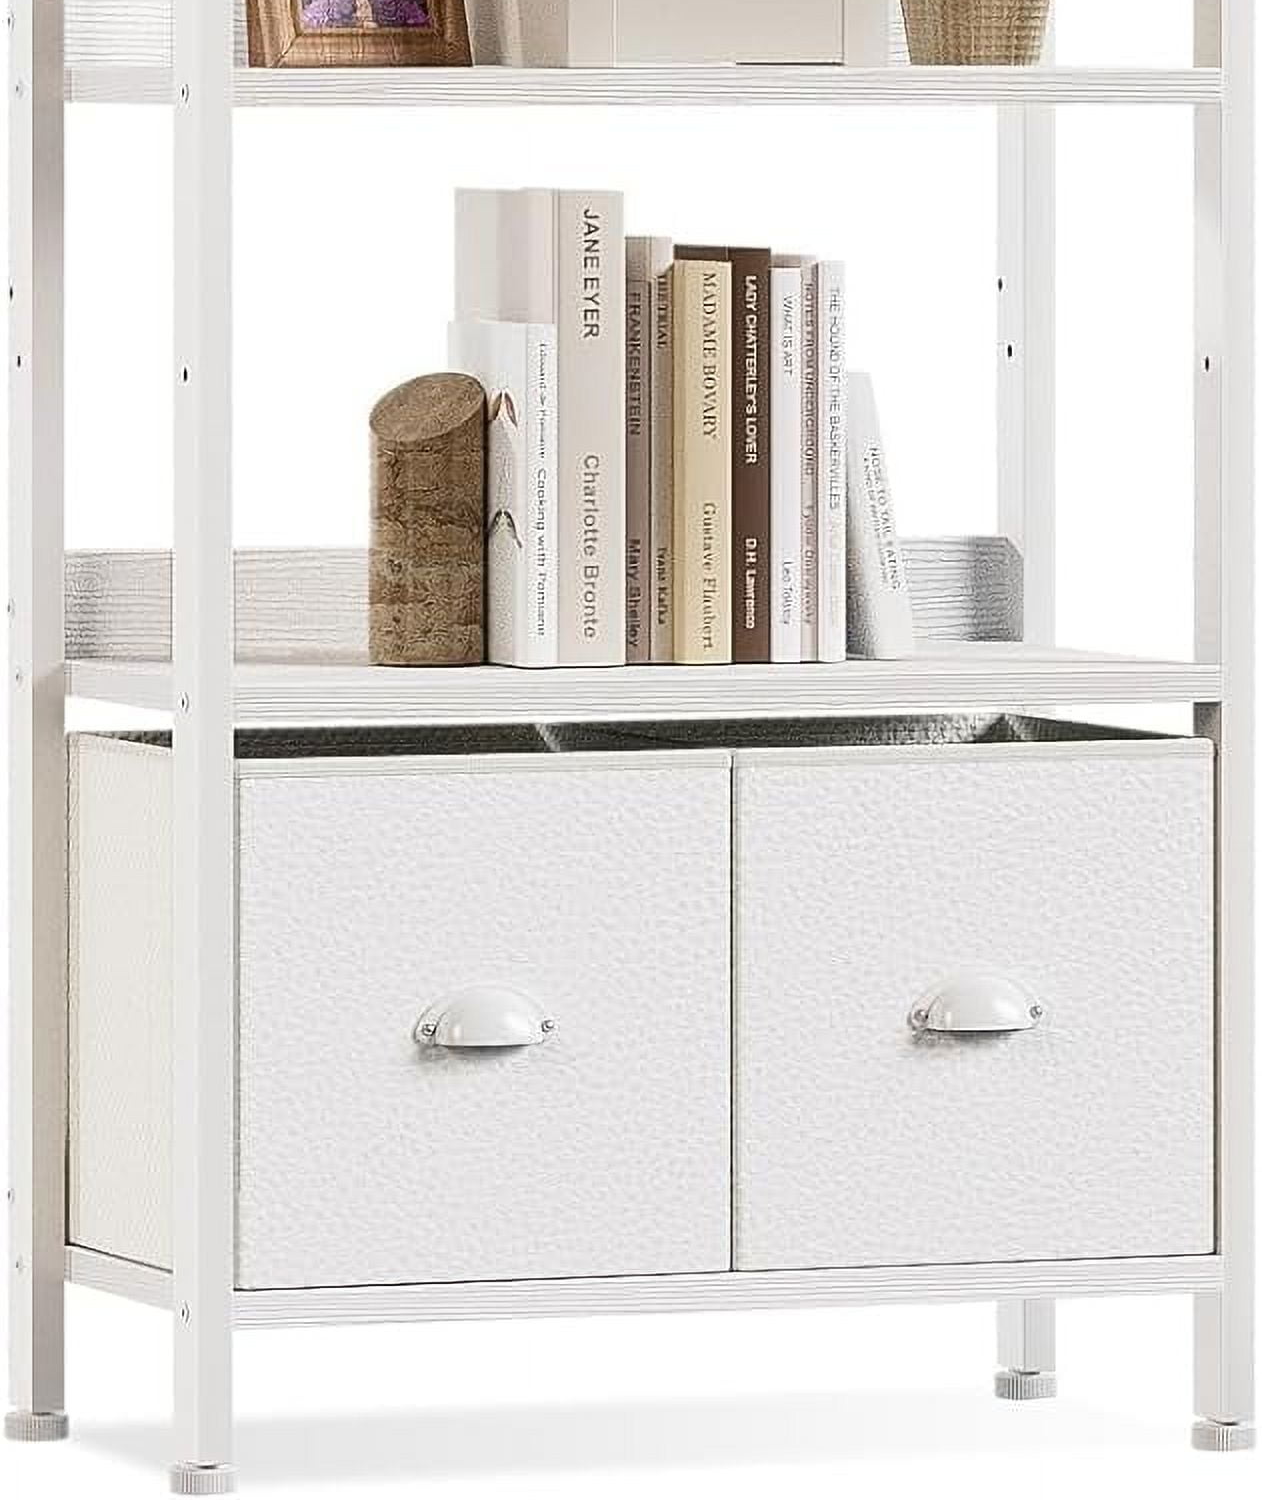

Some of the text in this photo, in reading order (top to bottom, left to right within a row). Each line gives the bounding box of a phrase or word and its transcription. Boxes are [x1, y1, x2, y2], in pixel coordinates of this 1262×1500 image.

[583, 208, 600, 339] JANE EYER
[745, 275, 757, 310] LADY
[829, 286, 841, 312] THE
[628, 292, 641, 436] FRANKENSTEIN
[702, 273, 717, 438] MADAME BOVARY
[782, 296, 793, 377] WHAT IS ART
[829, 365, 841, 383] OF
[829, 388, 841, 412] THE
[745, 417, 757, 464] LOVER
[536, 468, 548, 531] Cooking
[583, 454, 599, 558] Charlotte
[627, 538, 642, 580] Mary
